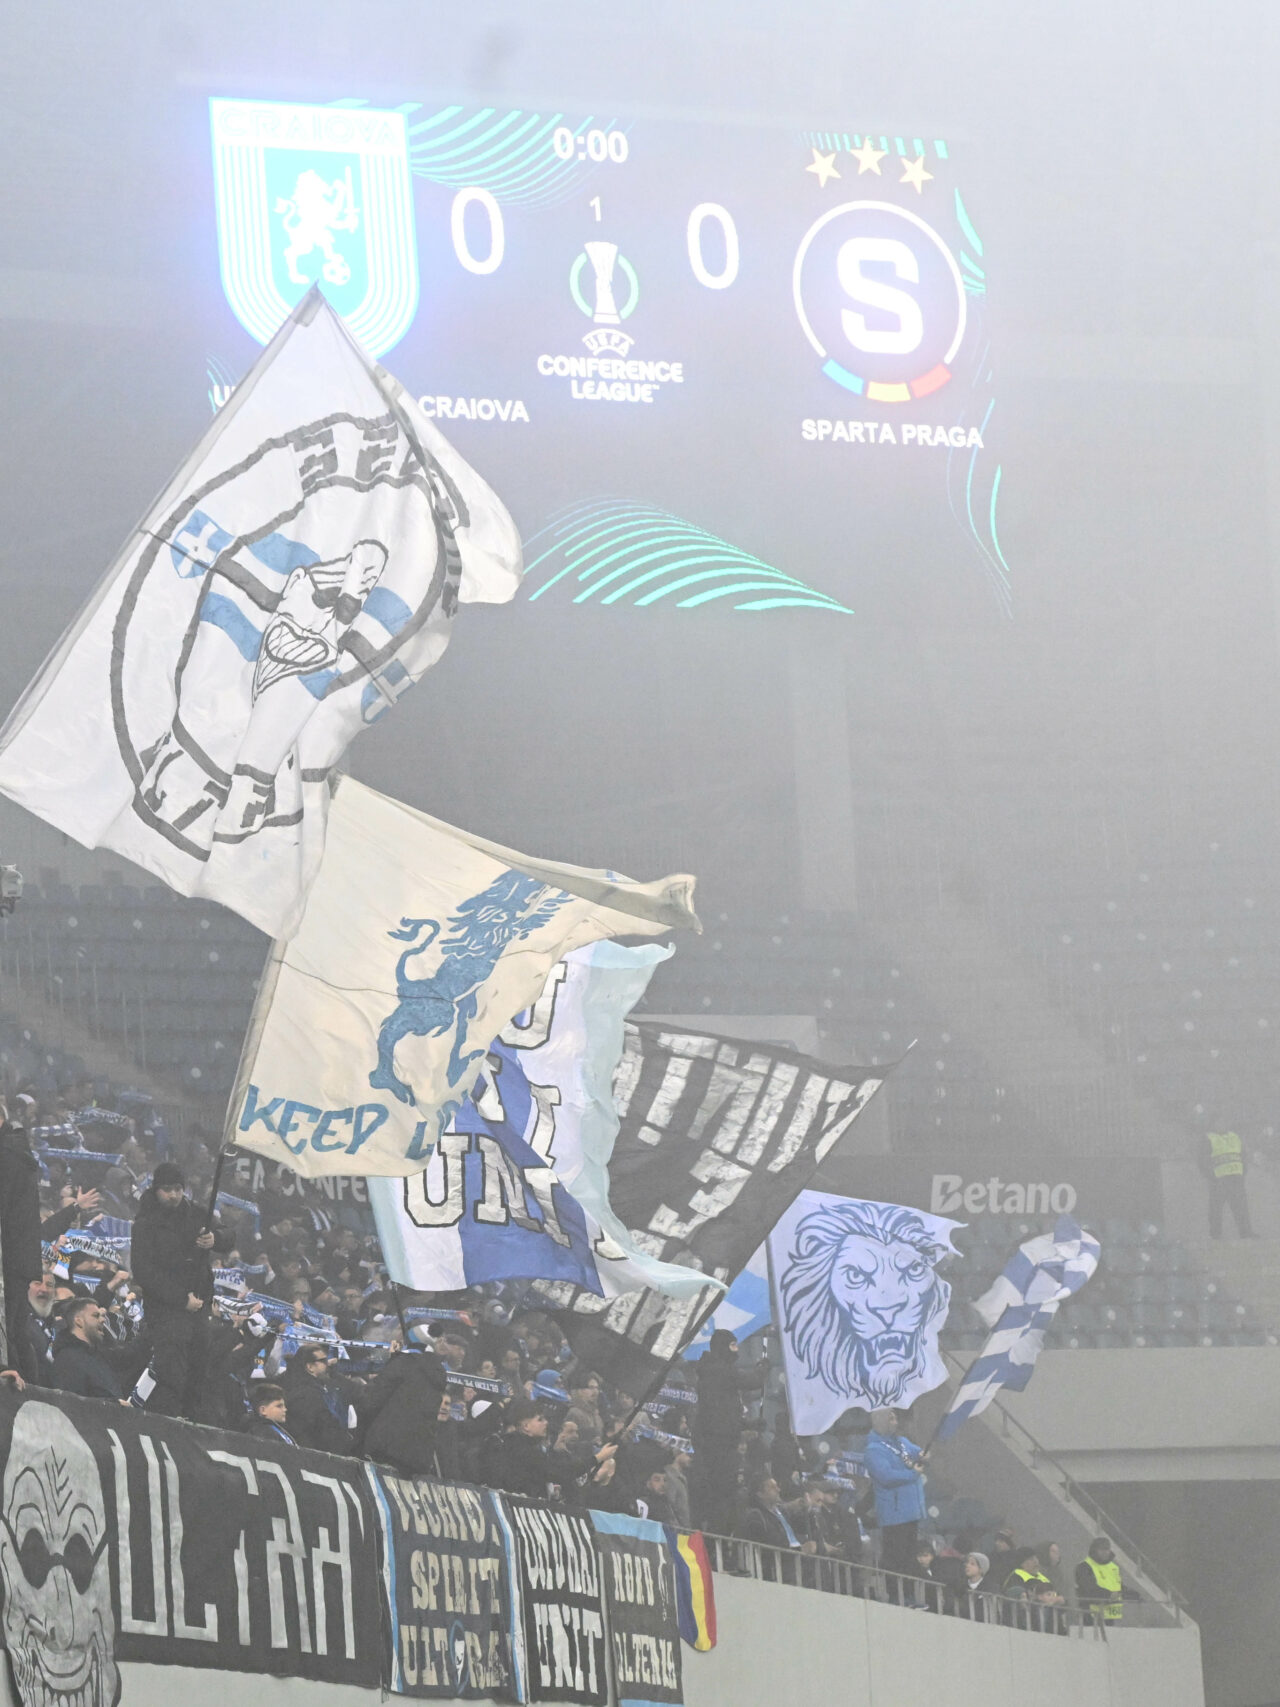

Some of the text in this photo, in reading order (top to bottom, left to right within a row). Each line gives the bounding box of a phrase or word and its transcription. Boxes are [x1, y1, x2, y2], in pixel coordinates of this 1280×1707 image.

[553, 126, 629, 164] 0:00
[451, 186, 505, 275] 0
[686, 203, 740, 289] 0
[584, 332, 631, 358] UEFA
[537, 354, 685, 383] CONFERENCE
[418, 395, 530, 423] CRAIOVA
[801, 419, 985, 449] SPARTA PRAGA
[239, 1083, 389, 1155] KEEP
[930, 1174, 1077, 1214] Betano
[410, 1550, 500, 1615] SPIRIT
